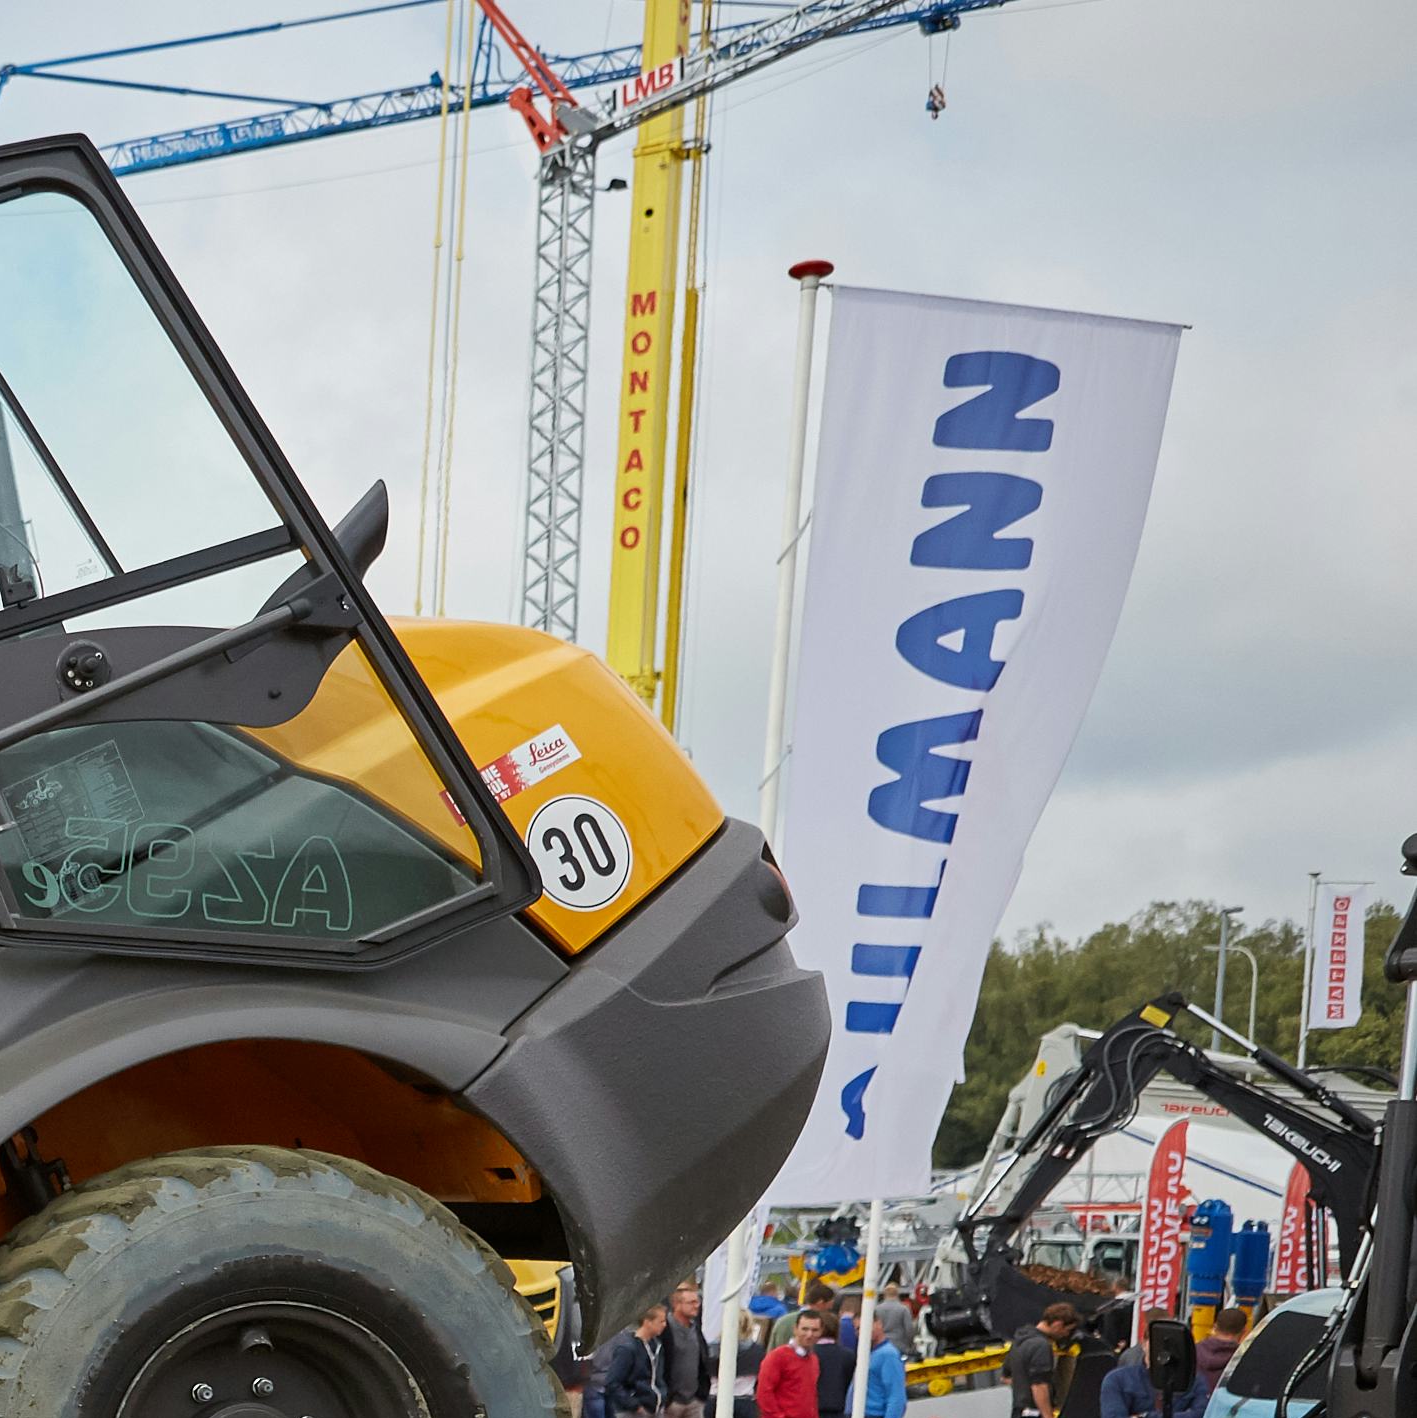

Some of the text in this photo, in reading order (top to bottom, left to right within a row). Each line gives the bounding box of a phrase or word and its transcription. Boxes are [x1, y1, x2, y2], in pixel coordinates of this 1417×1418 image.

[622, 62, 674, 107] LMB
[620, 290, 657, 550] MONTACO
[529, 737, 568, 767] Leica
[541, 813, 617, 892] 30
[1141, 1199, 1163, 1312] NIEUW
